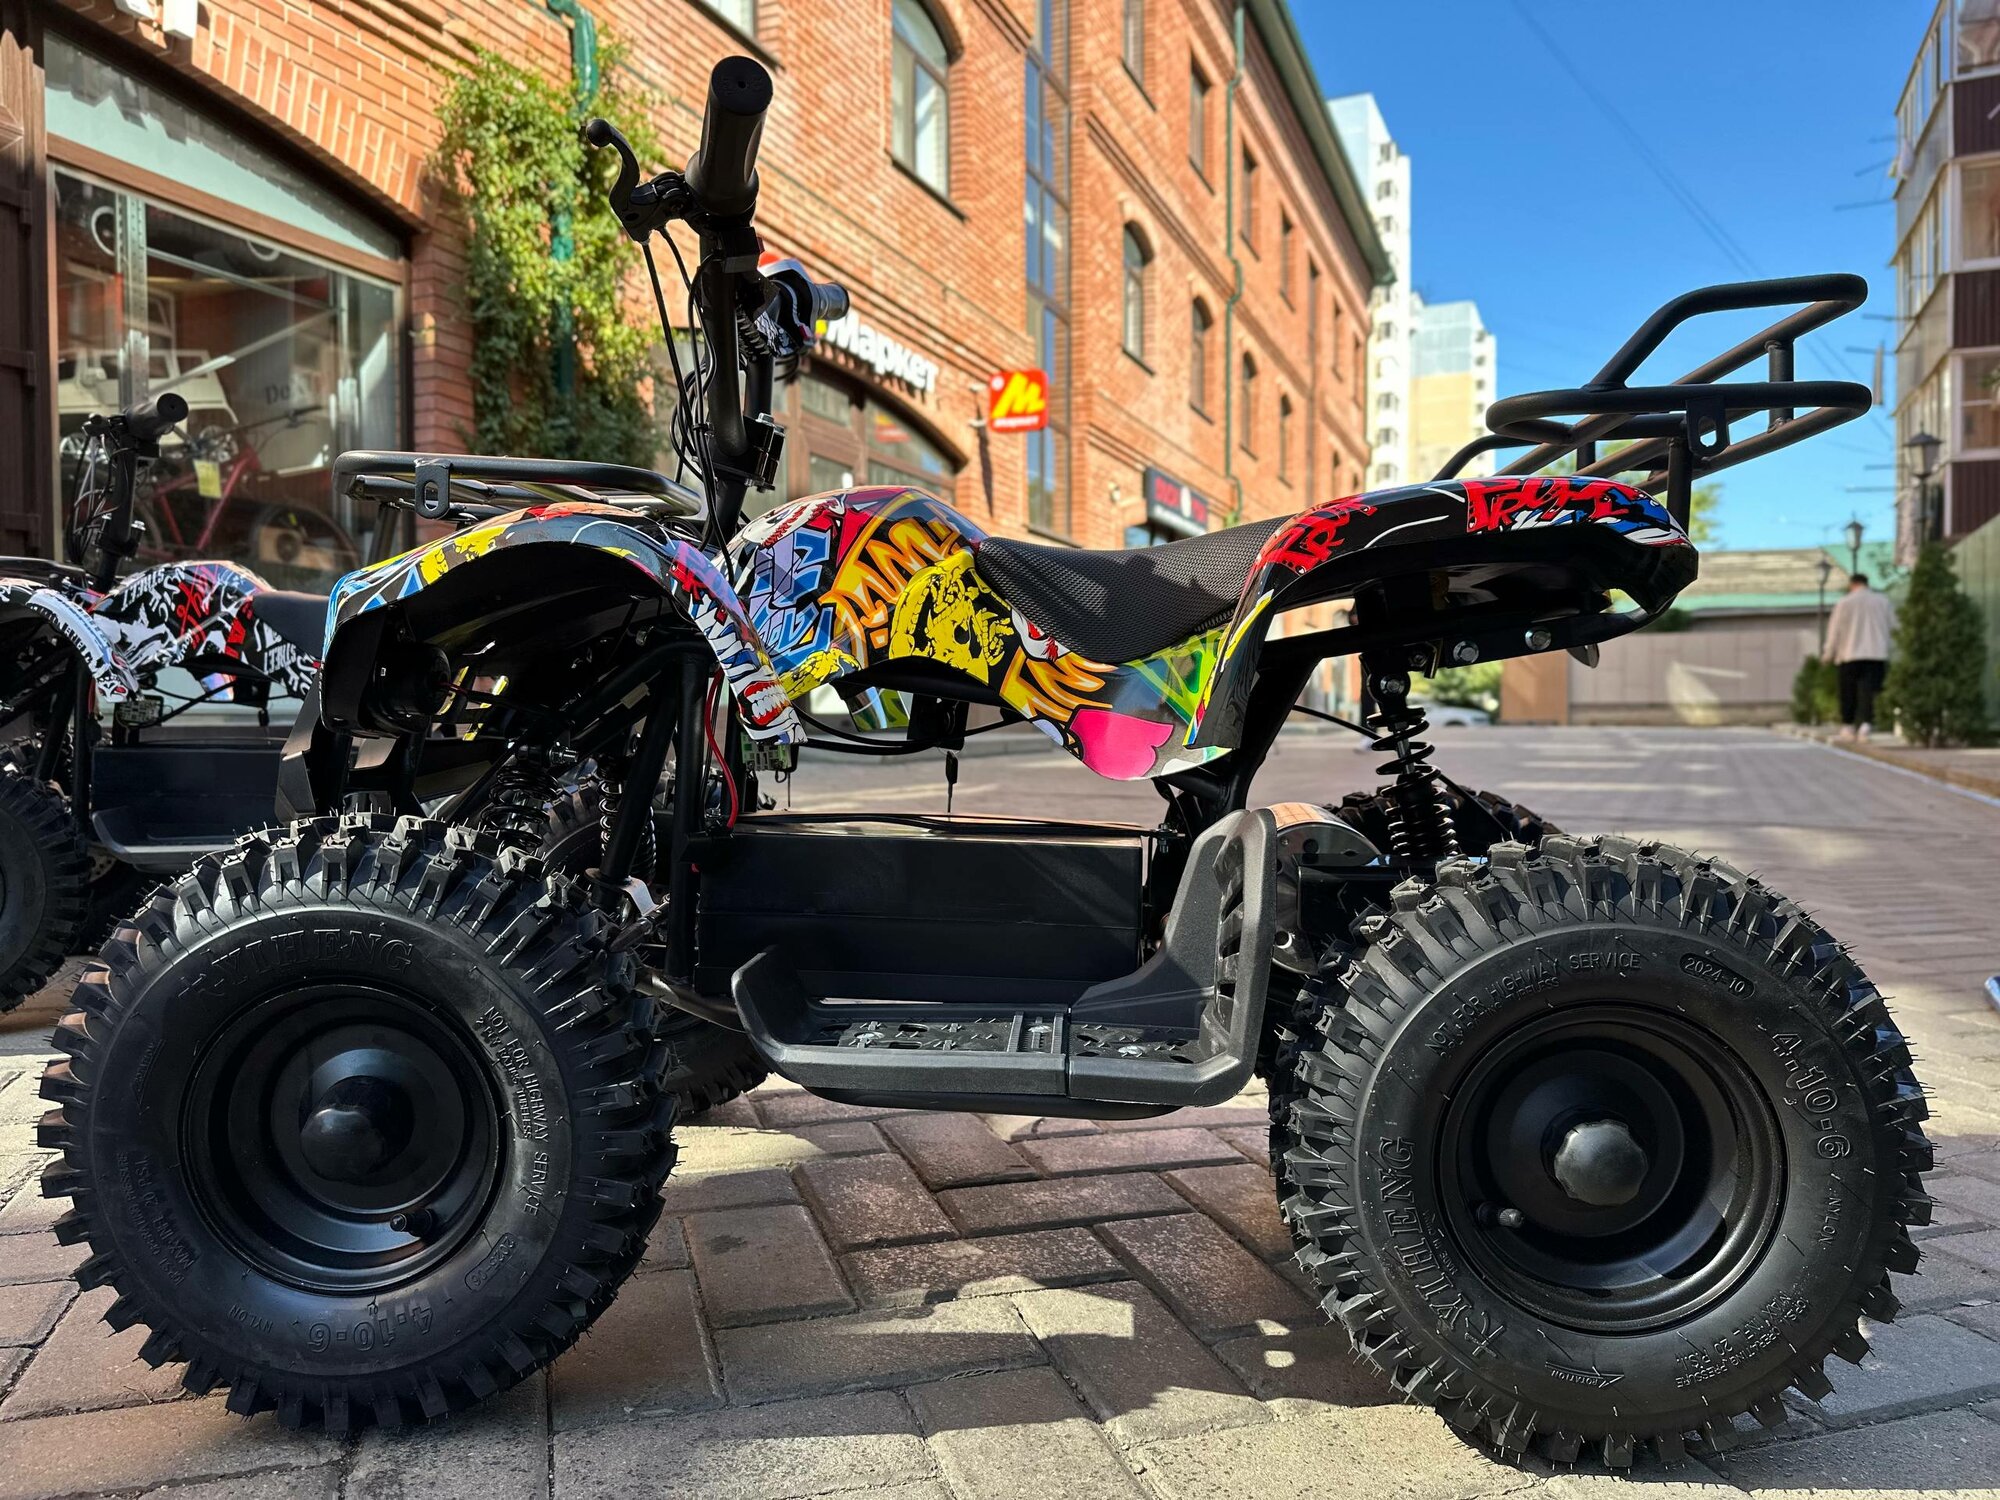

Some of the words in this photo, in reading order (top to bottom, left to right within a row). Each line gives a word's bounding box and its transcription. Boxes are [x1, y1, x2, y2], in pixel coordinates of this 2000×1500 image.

[826, 308, 939, 393] Маркет
[1685, 956, 1745, 994] 2024-10
[484, 1006, 512, 1035] NOT
[1425, 1022, 1449, 1055] NOT
[1453, 996, 1486, 1020] FOR
[1569, 952, 1641, 970] SERVICE
[507, 1038, 530, 1068] FOR
[523, 1072, 549, 1143] HIGHWAY
[1773, 1033, 1851, 1159] 4.10-6
[523, 1151, 549, 1217] SERVICE
[1818, 1196, 1843, 1245] NYLON
[1714, 1338, 1733, 1356] 20
[1675, 1359, 1728, 1388] PRESSURE
